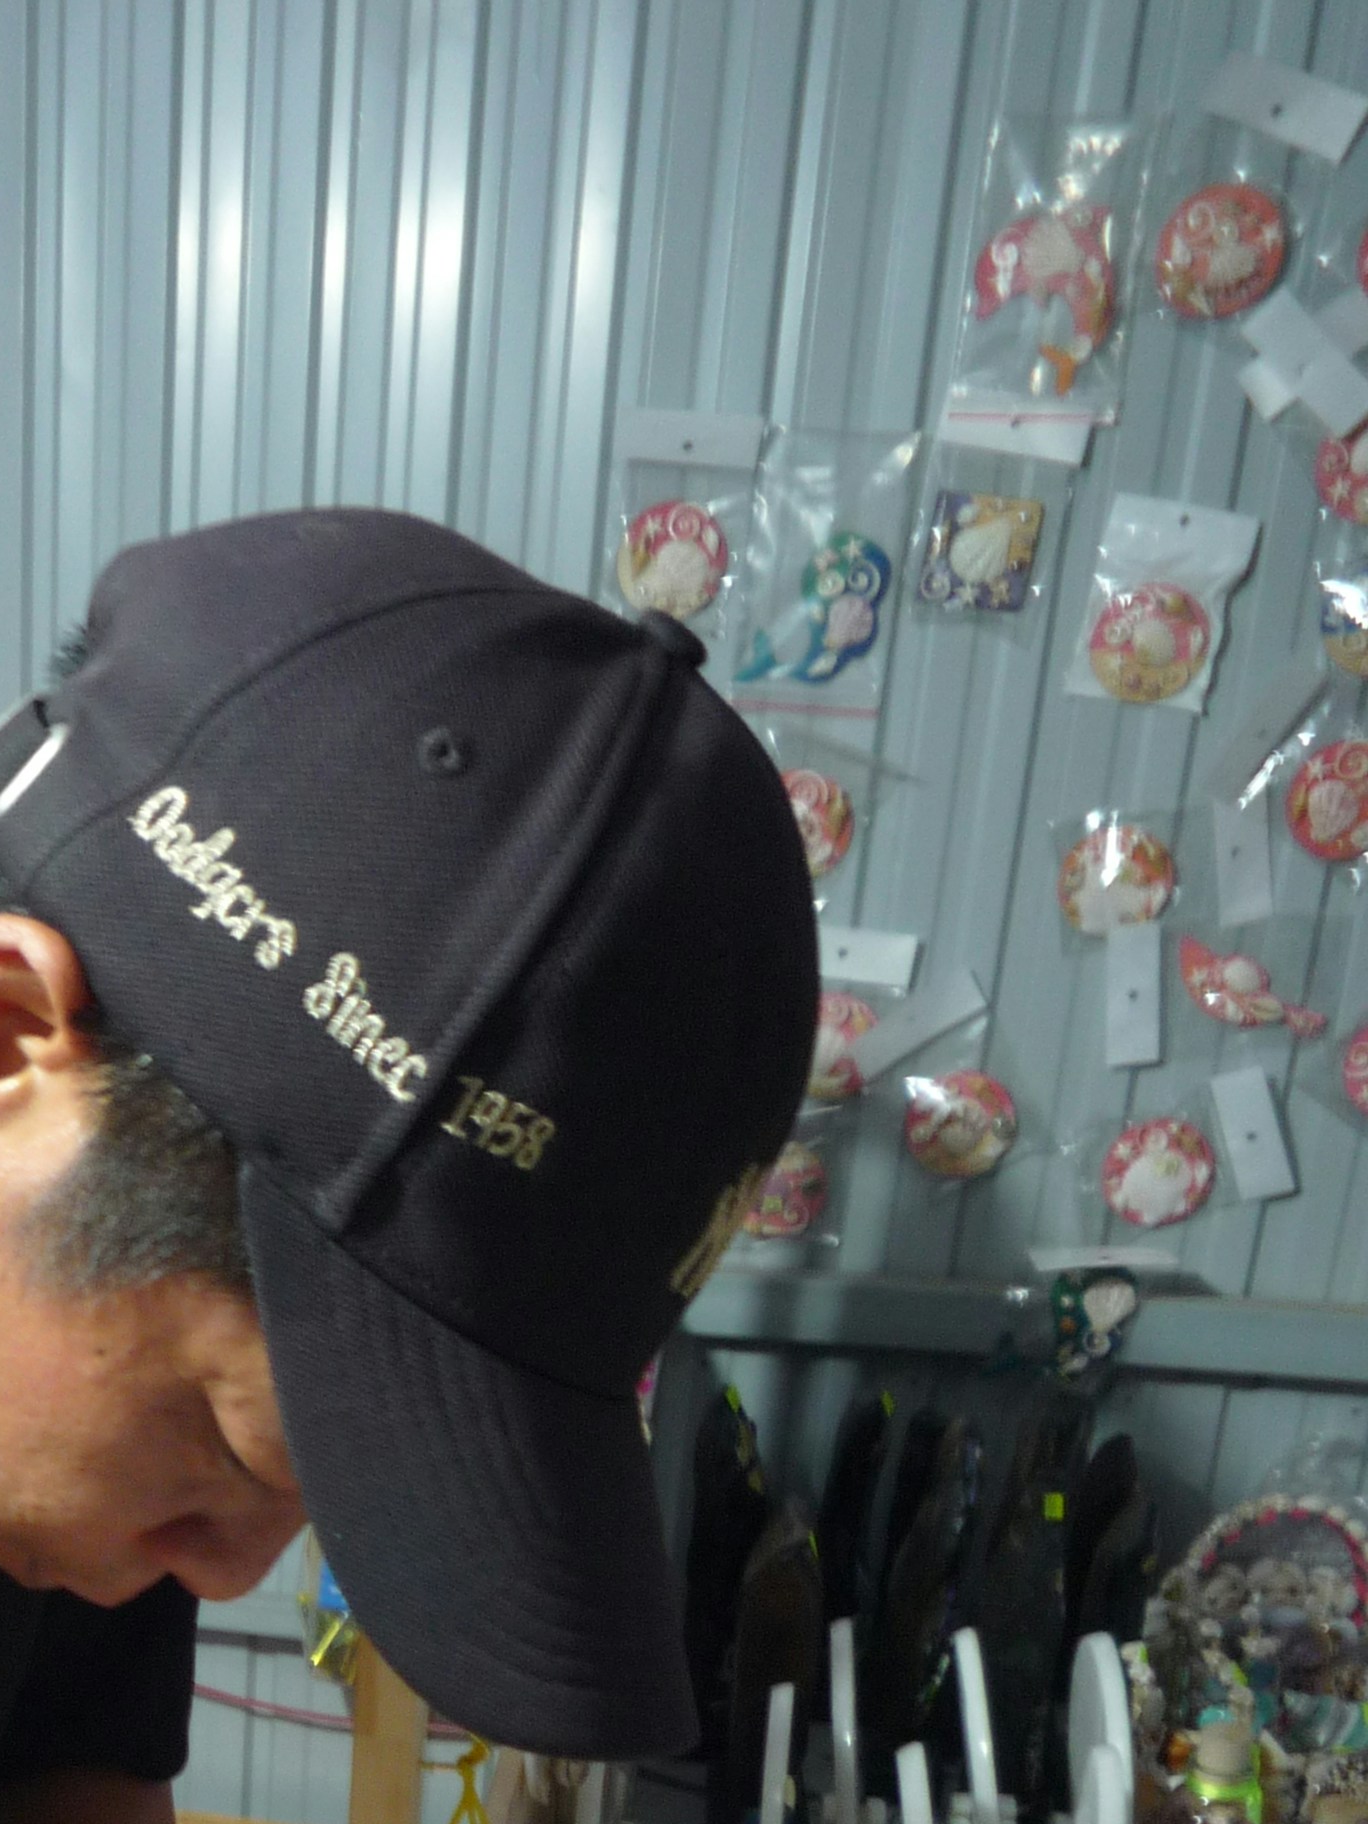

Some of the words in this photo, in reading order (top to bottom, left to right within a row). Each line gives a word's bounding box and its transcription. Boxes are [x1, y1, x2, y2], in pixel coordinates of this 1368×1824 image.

[126, 784, 299, 971] Dodgers
[303, 952, 432, 1103] Since
[438, 1074, 558, 1173] 1958
